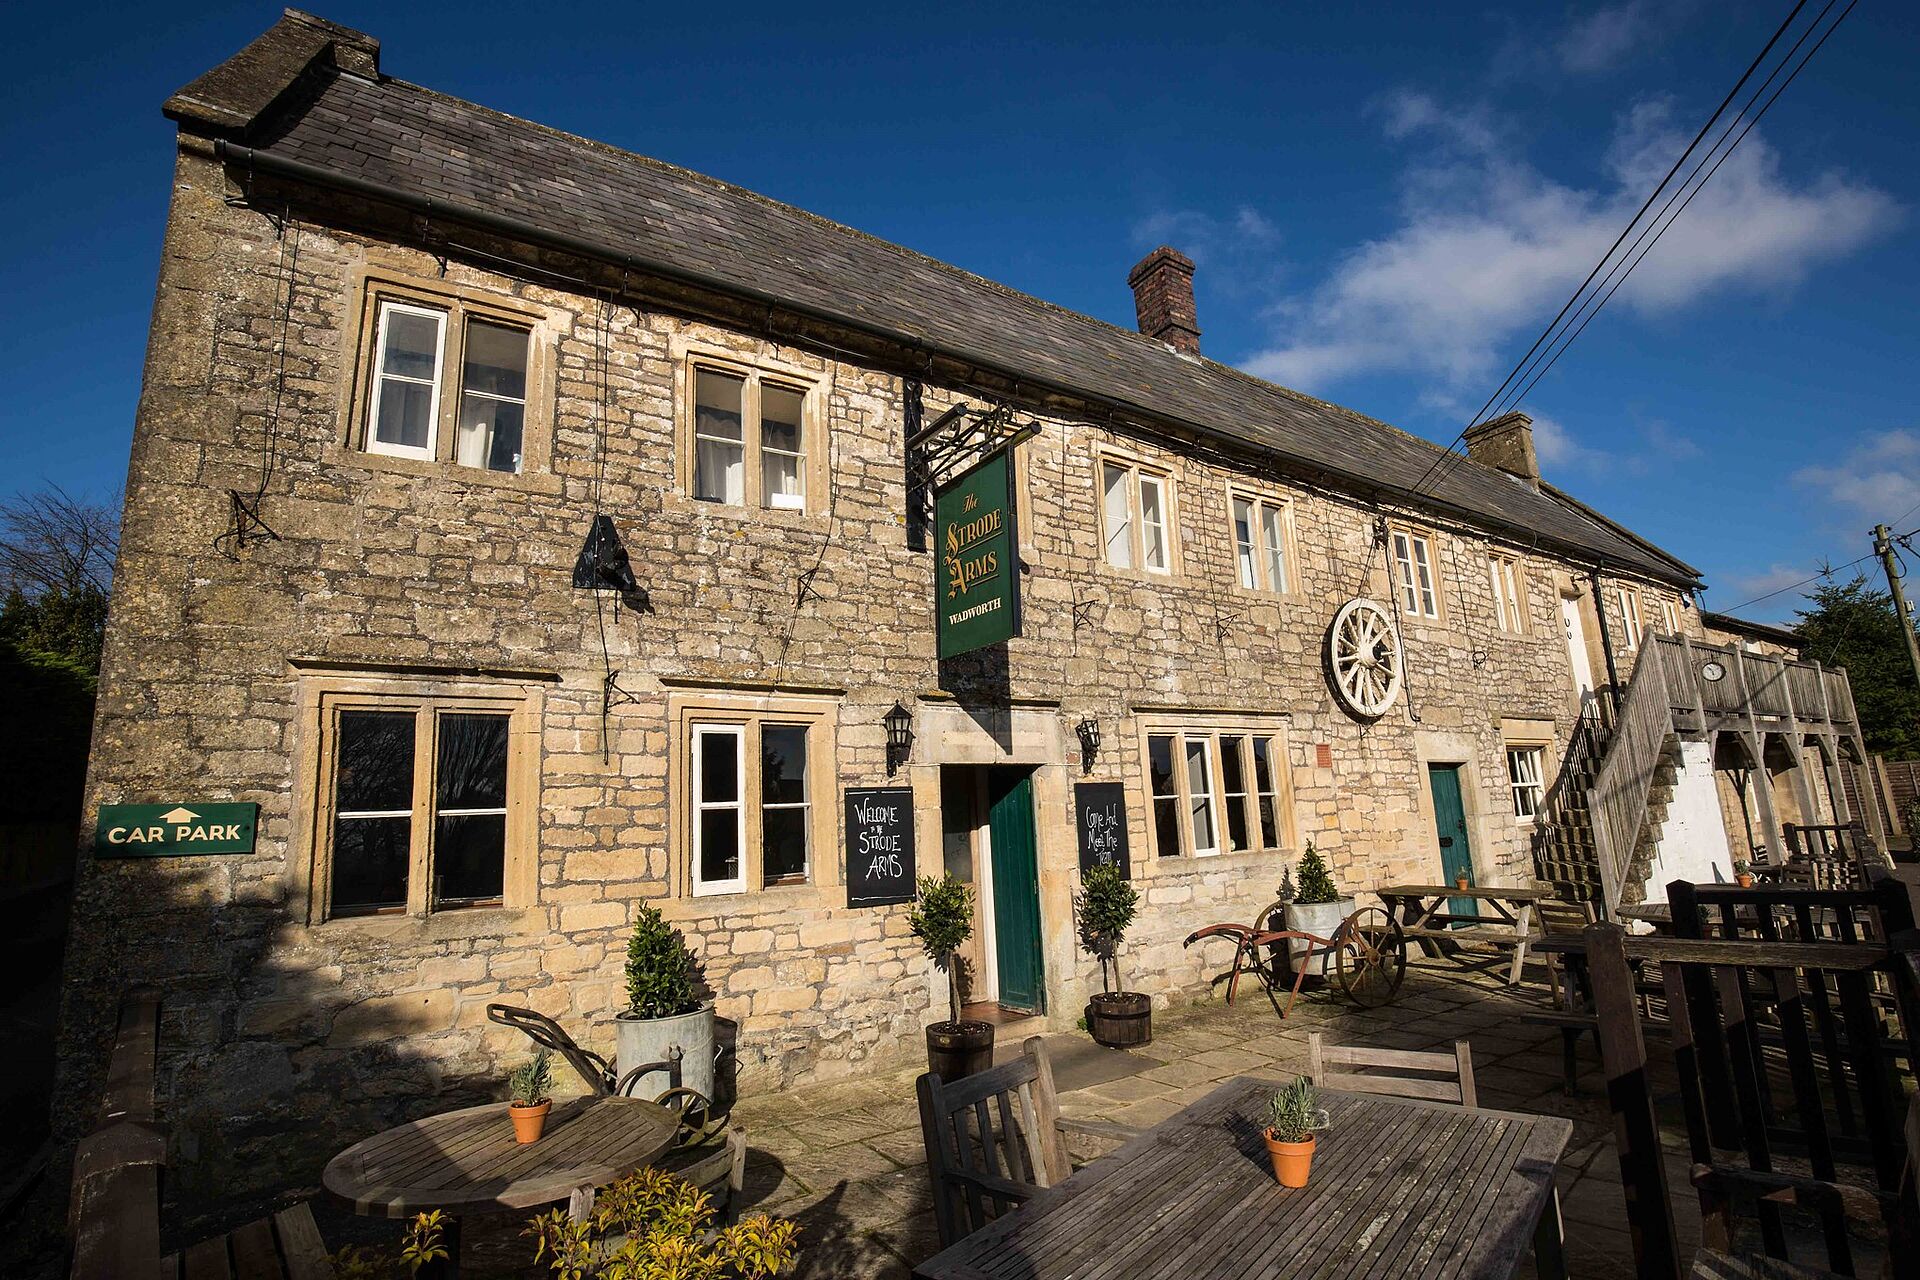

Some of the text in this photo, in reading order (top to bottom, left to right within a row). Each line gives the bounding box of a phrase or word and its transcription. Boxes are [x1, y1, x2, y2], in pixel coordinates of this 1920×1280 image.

[961, 493, 978, 514] The
[943, 508, 1002, 565] STRODE
[948, 551, 998, 600] ARMS
[949, 597, 1002, 625] WADWORTH
[854, 797, 899, 826] WELCOME
[108, 824, 241, 844] CAR PARK
[859, 831, 902, 854] STRODE
[865, 854, 903, 880] ARMS
